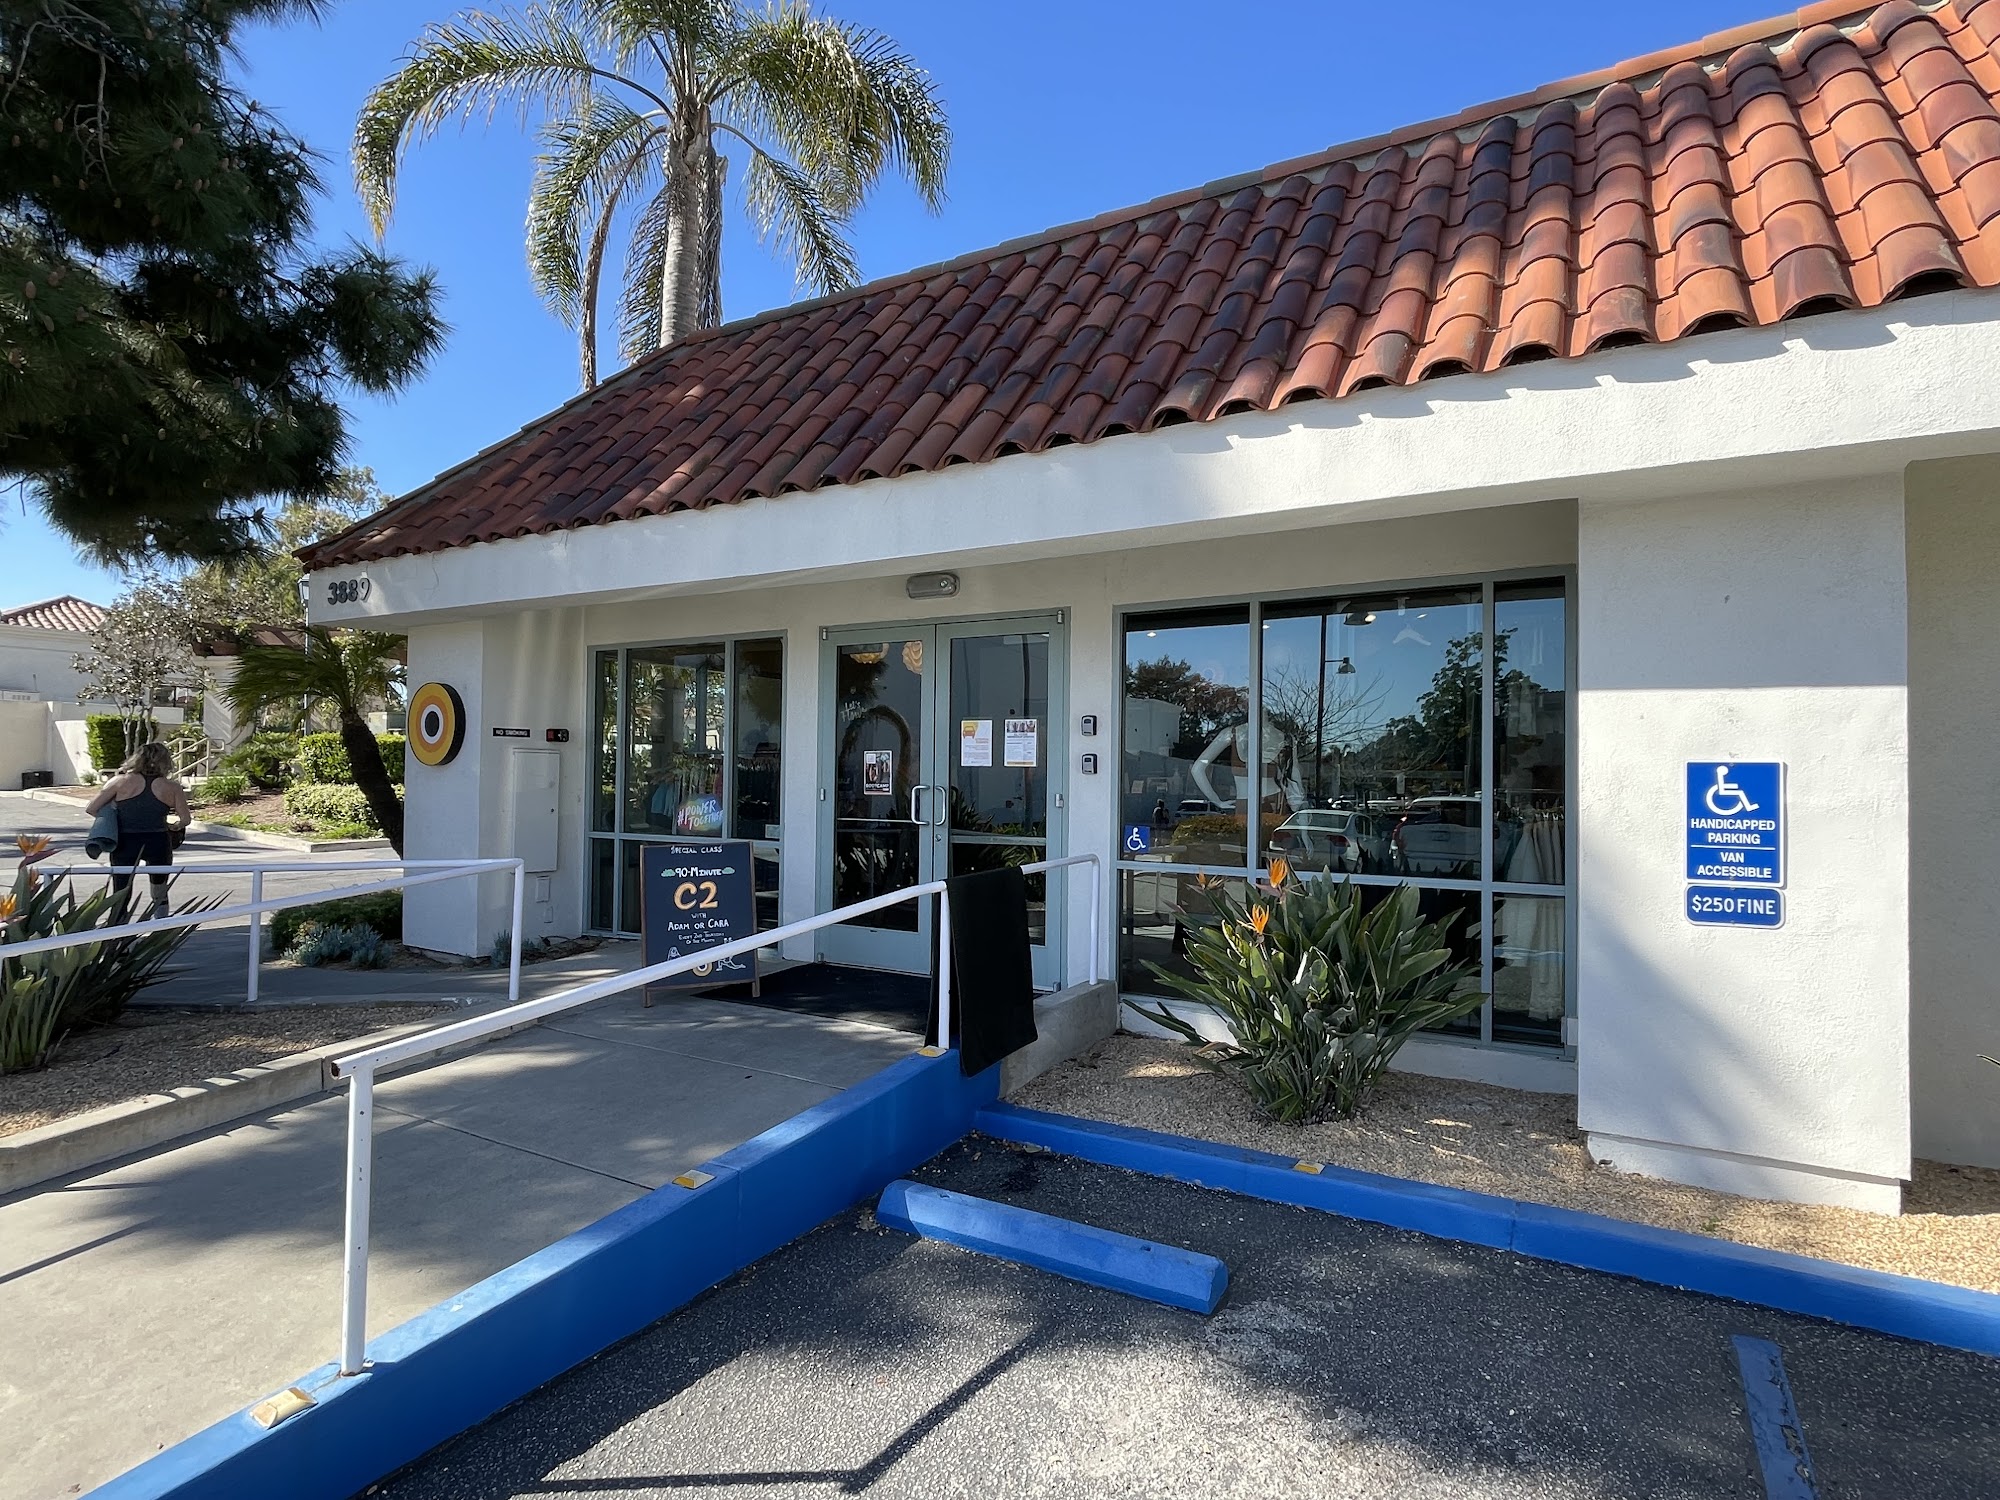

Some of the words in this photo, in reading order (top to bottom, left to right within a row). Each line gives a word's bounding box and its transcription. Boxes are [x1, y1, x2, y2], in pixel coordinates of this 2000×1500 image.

[327, 578, 371, 605] 3889
[1691, 818, 1776, 831] HANDICAPPED
[1708, 833, 1760, 845] PARKING
[700, 844, 723, 854] CLASS
[1720, 852, 1744, 863] VAN
[1697, 866, 1772, 878] ACCESSIBLE
[674, 882, 719, 910] C2
[1692, 895, 1735, 913] $250
[1738, 899, 1776, 915] FINE
